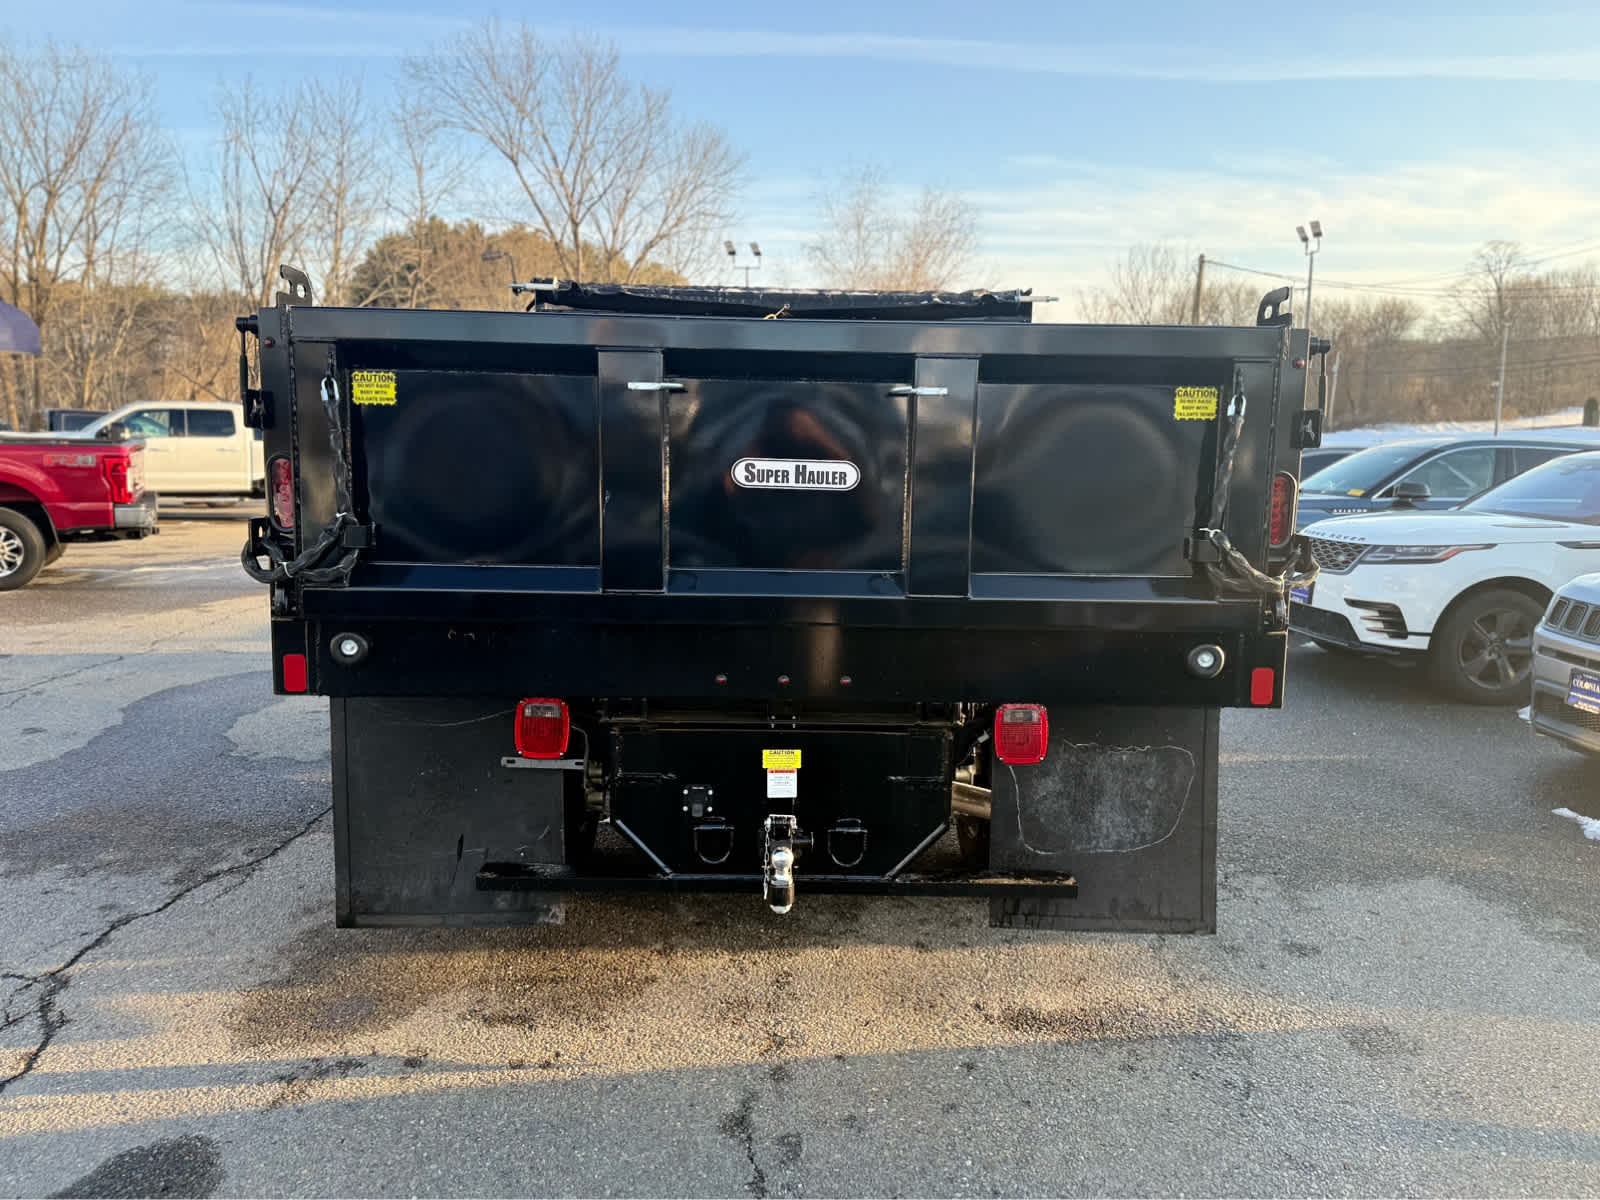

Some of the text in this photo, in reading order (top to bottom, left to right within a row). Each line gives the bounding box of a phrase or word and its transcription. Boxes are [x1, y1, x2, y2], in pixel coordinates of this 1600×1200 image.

[353, 374, 393, 382] CAUTION
[1177, 389, 1216, 398] CAUTION
[744, 462, 847, 486] SUPER HAULER
